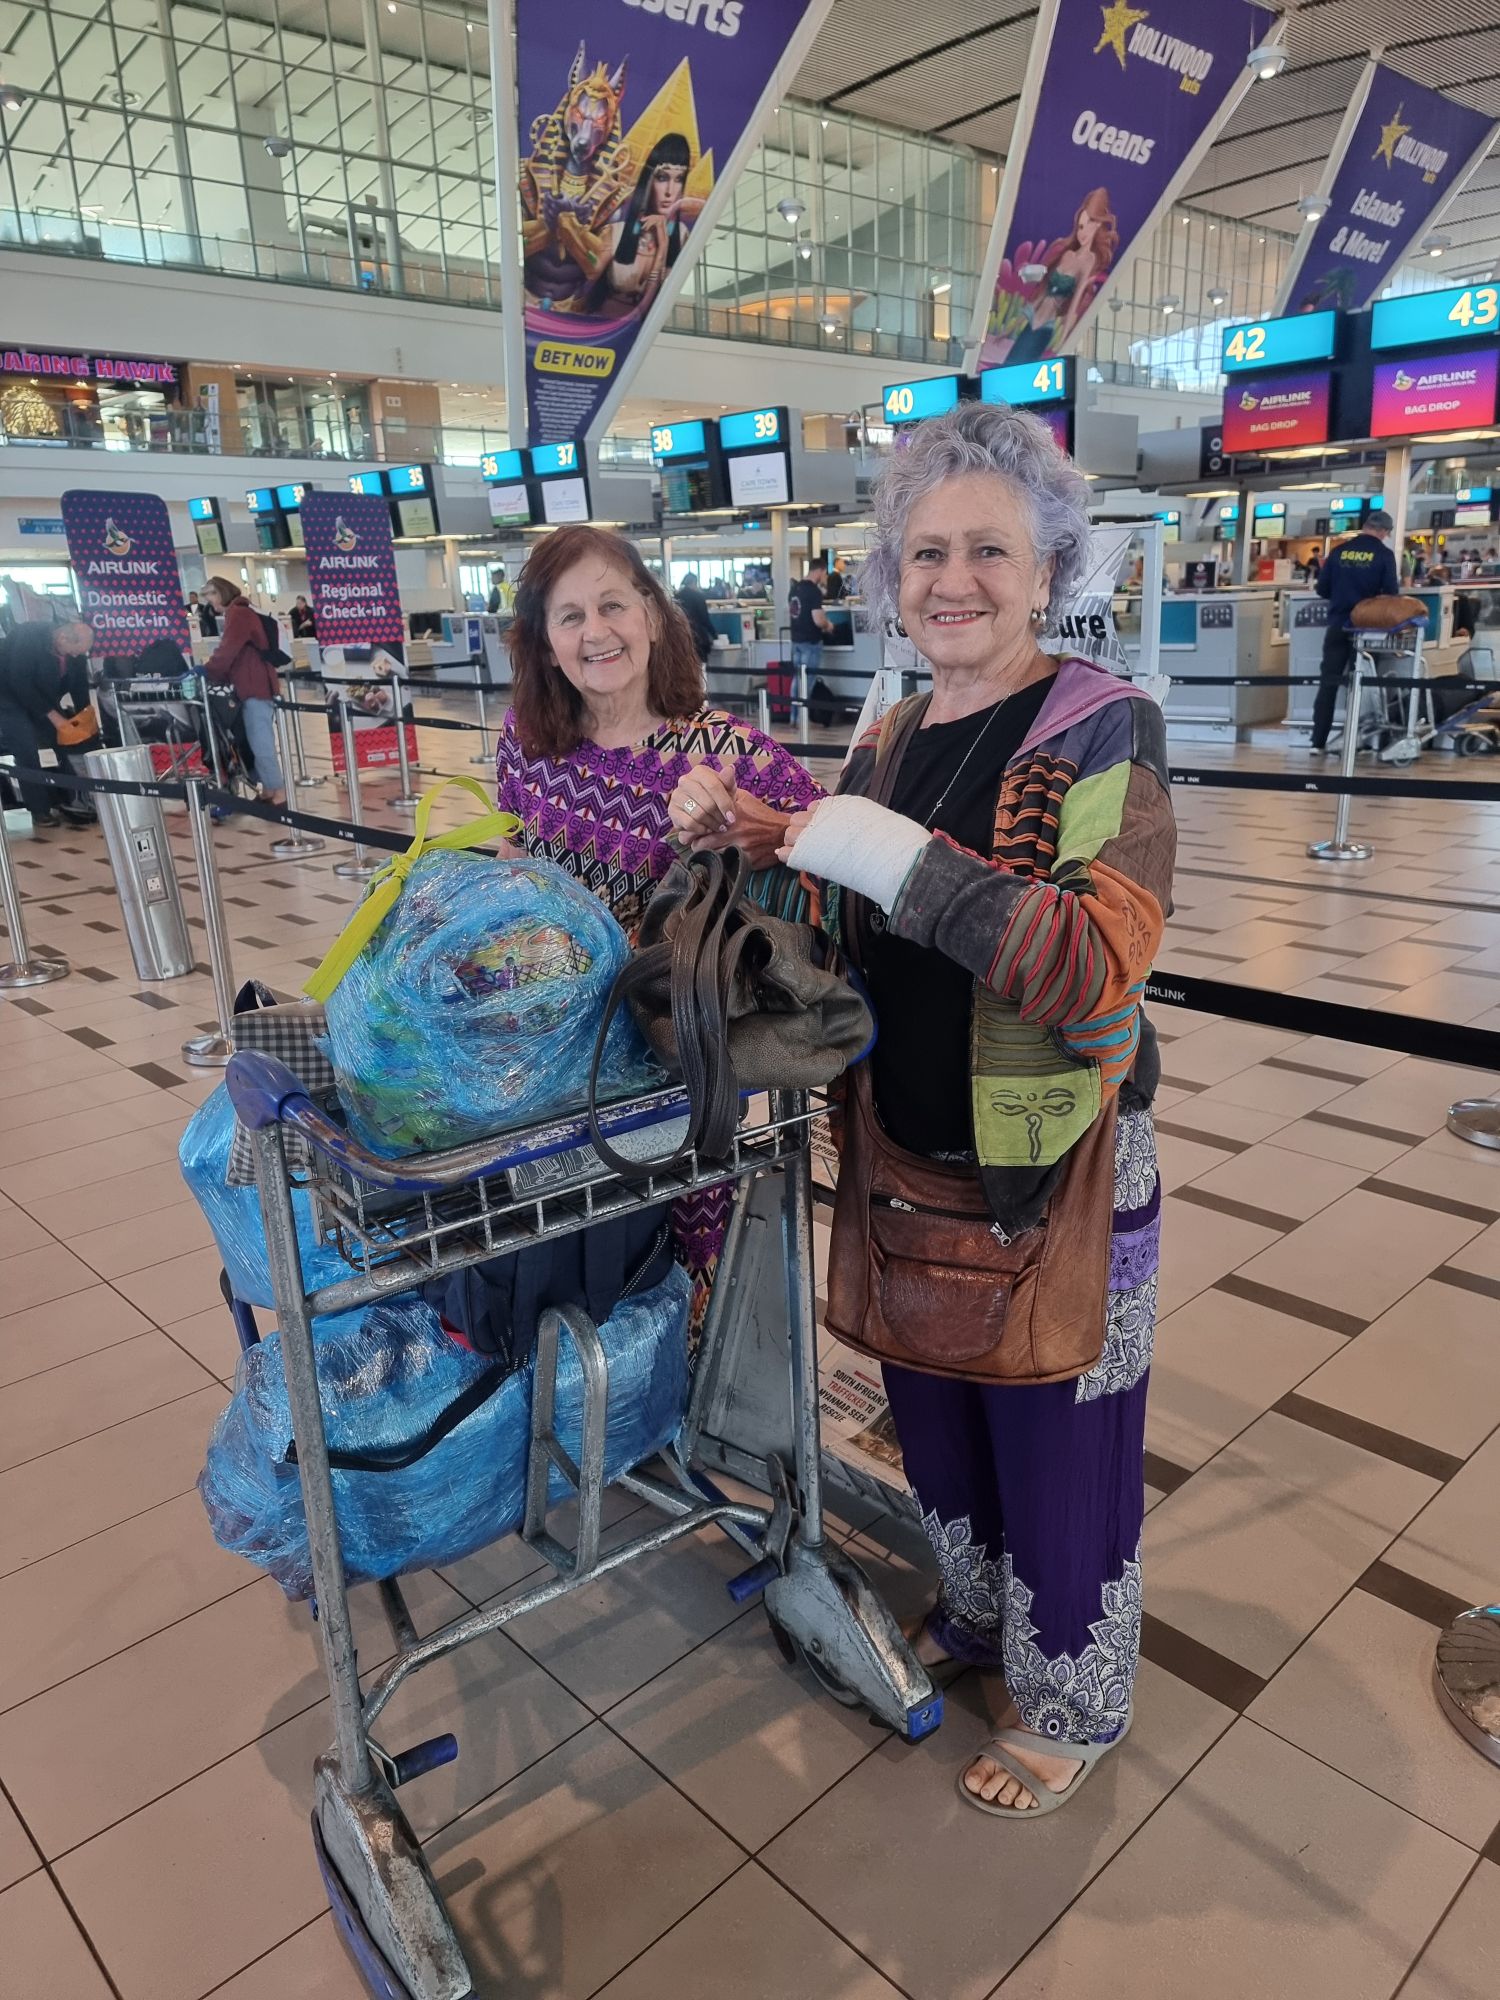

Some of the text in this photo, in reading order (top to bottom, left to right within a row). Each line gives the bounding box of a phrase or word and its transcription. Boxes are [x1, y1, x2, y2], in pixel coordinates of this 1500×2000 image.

[1128, 22, 1214, 80] HOLLYWOOD
[1072, 110, 1155, 164] Oceans
[1350, 188, 1405, 228] Islands
[1329, 226, 1390, 264] & More!
[1448, 288, 1498, 327] 43
[1226, 327, 1266, 362] 42
[0, 352, 175, 382] ARING HAWK
[540, 349, 609, 370] BET NOW
[1033, 362, 1063, 393] 41
[1417, 369, 1477, 386] AIRLINK
[886, 388, 914, 416] 40
[1260, 391, 1312, 406] AIRLINK
[1404, 401, 1461, 415] BAG DROP
[754, 412, 778, 438] 39
[1250, 419, 1298, 433] BAG DROP
[652, 429, 673, 452] 38
[557, 443, 575, 466] 37
[482, 455, 498, 476] 36
[350, 477, 364, 494] 34
[408, 466, 424, 487] 35
[247, 493, 258, 509] 32
[88, 561, 158, 575] AIRLINK
[319, 556, 379, 569] AIRLINK
[88, 591, 167, 607] Domestic
[321, 582, 383, 601] Regional
[93, 612, 169, 629] Check-in
[322, 604, 386, 619] Check-in
[1057, 613, 1107, 639] ure
[1145, 985, 1186, 1001] IRLINK
[827, 1381, 876, 1414] TRAFFICKED TO
[833, 1369, 857, 1388] SOUTH
[854, 1383, 888, 1407] AFRICANS
[819, 1388, 868, 1424] MYANMAR SEEK
[820, 1403, 846, 1423] RESCUE
